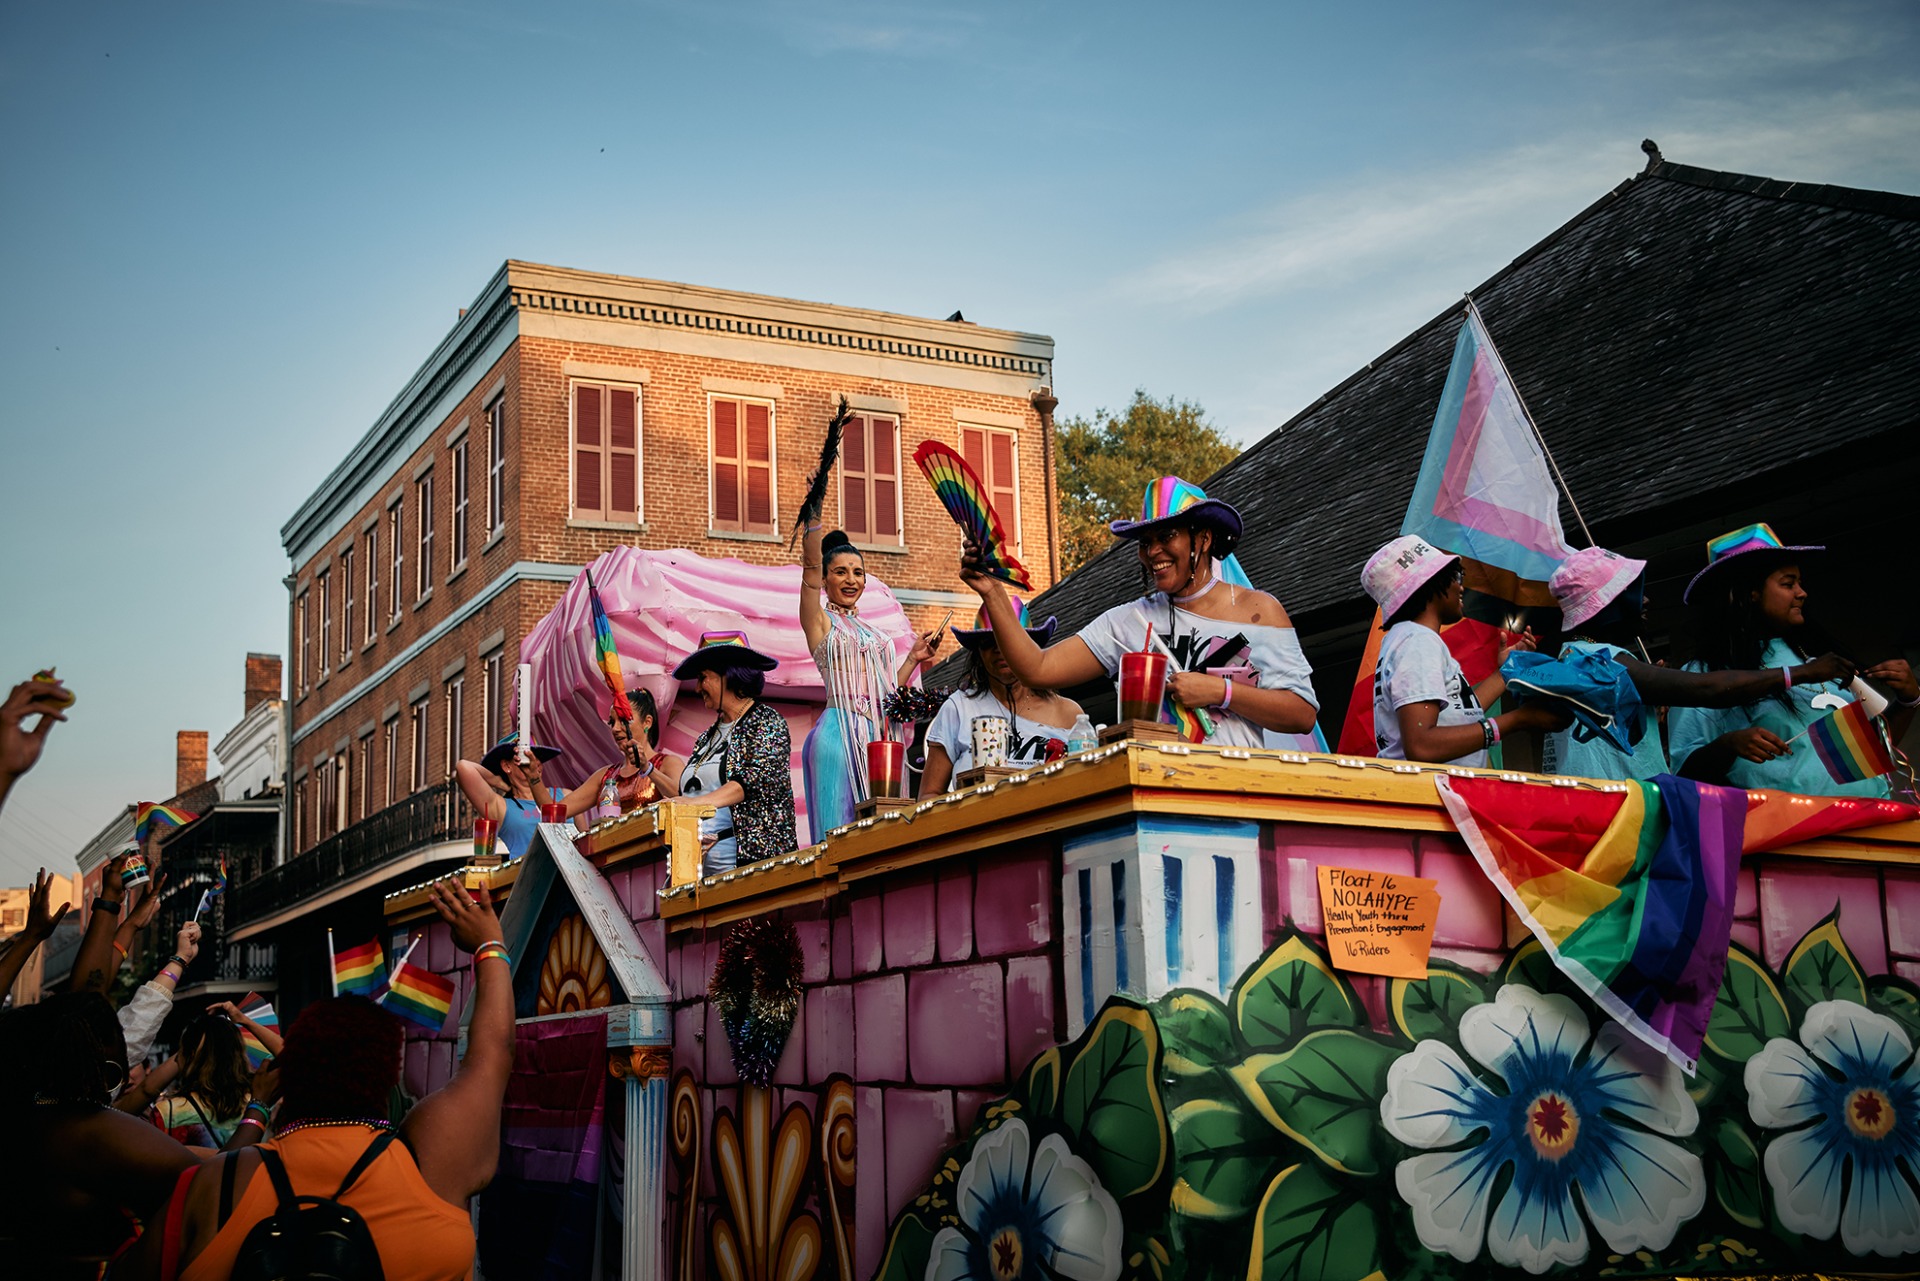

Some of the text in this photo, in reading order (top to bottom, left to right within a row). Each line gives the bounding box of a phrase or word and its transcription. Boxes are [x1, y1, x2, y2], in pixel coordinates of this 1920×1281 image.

[1330, 869, 1397, 890] Float 16
[1333, 888, 1418, 911] NOLAHYPE
[1356, 909, 1379, 922] Youth
[1381, 911, 1408, 921] thru
[1326, 922, 1369, 935] Prevention
[1376, 923, 1426, 937] Engagement
[1345, 940, 1390, 957] 16 Riders
